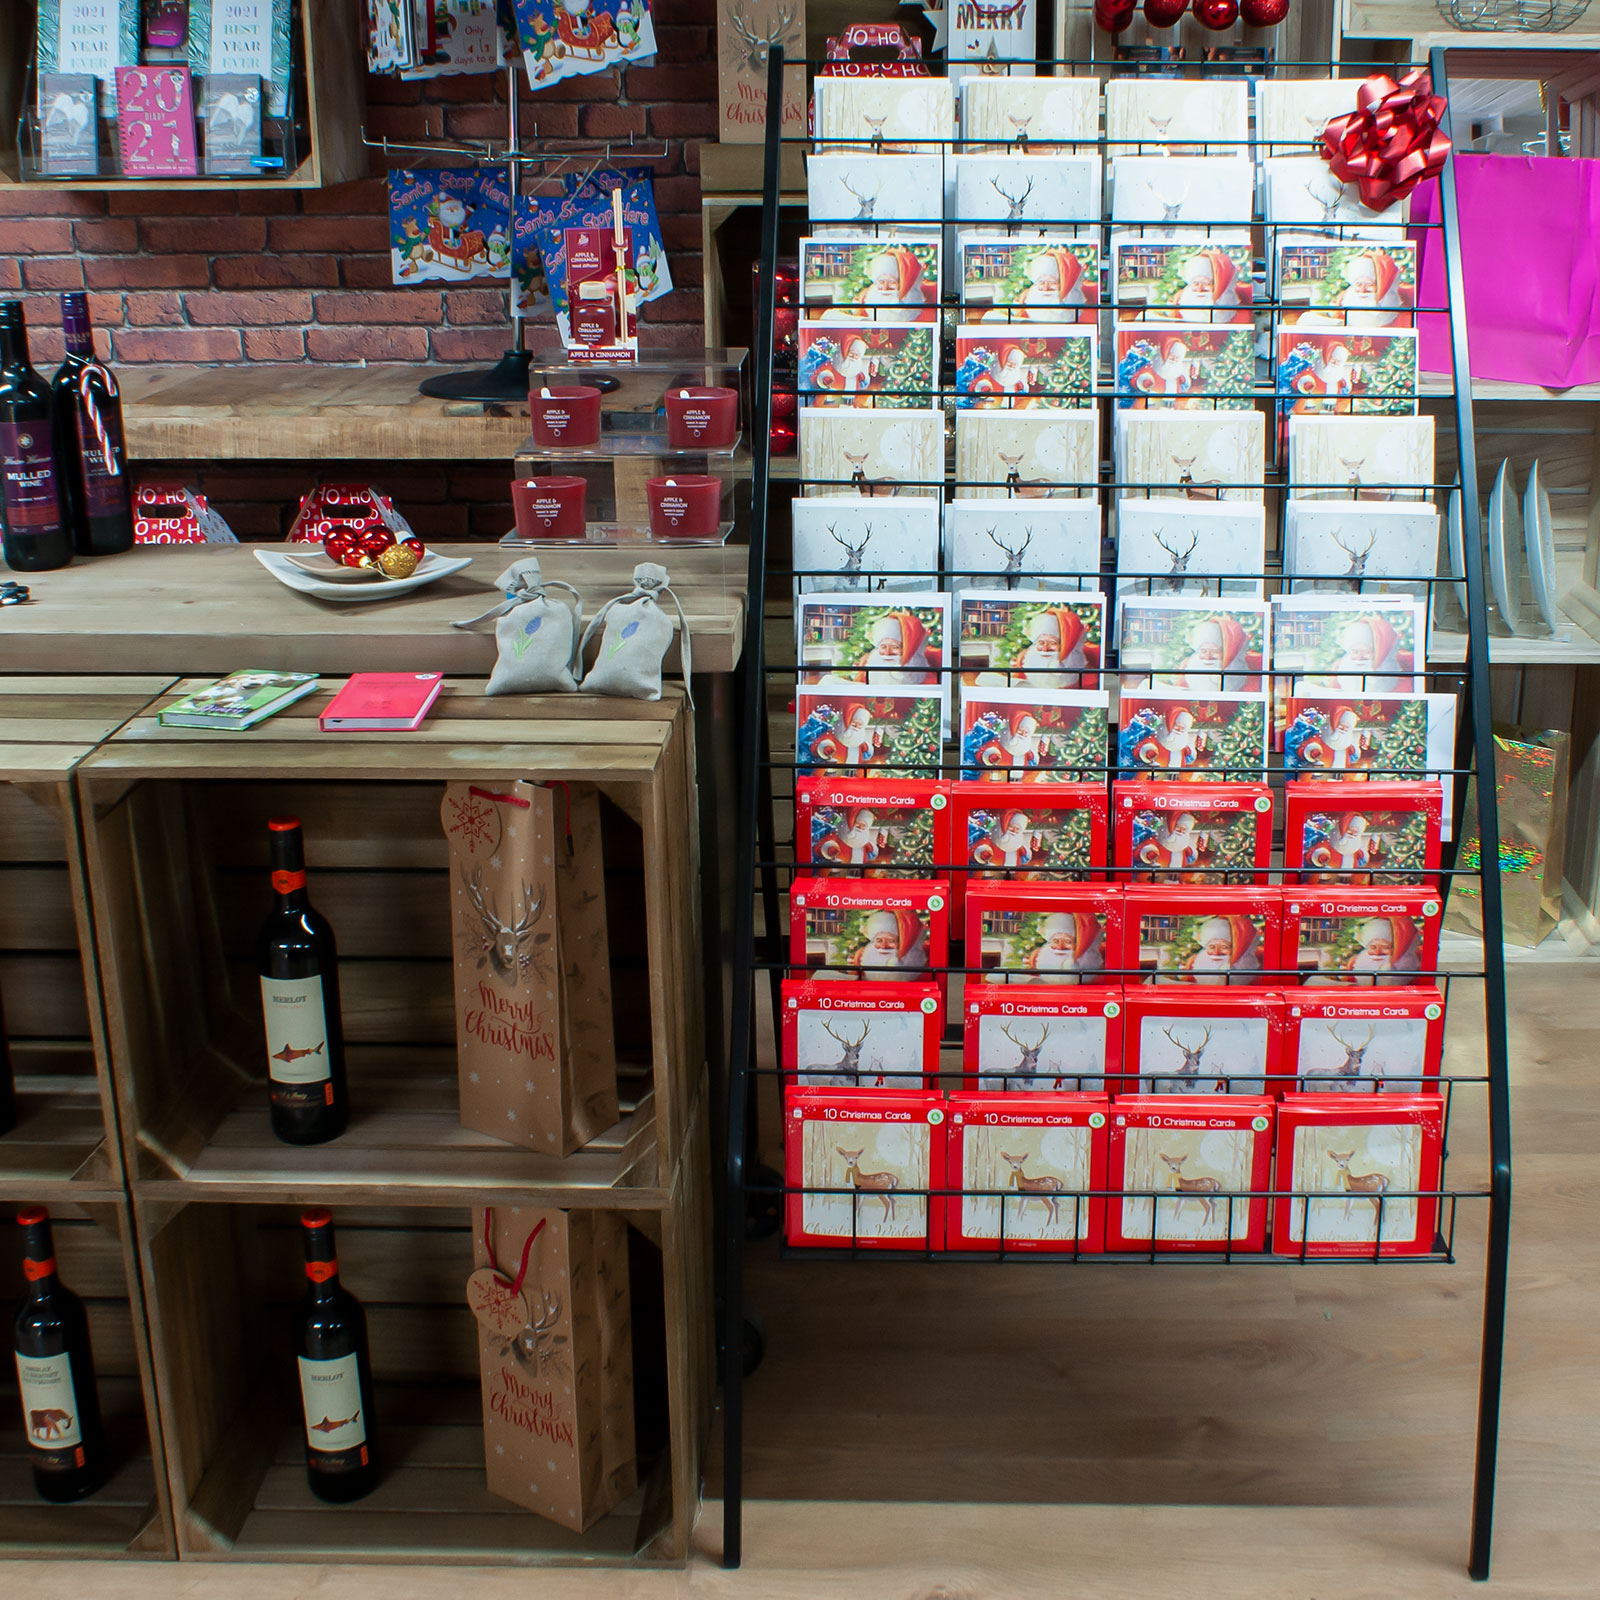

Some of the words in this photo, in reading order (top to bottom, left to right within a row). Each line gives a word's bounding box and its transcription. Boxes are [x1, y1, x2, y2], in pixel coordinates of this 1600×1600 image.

[72, 6, 105, 18] 2021
[225, 6, 258, 18] 2021
[956, 4, 1027, 30] MERRY
[71, 24, 107, 35] BEST
[224, 24, 260, 35] BEST
[465, 25, 485, 36] Only
[71, 41, 108, 52] YEAR
[223, 41, 261, 52] YEAR
[71, 57, 107, 68] EVER
[222, 57, 260, 69] EVER
[144, 112, 166, 120] DIARY
[390, 181, 433, 211] Santa
[439, 171, 475, 193] Stop
[514, 209, 555, 238] Santa
[6, 469, 52, 481] MULLED
[19, 480, 43, 488] WINE
[829, 793, 844, 804] 10
[846, 795, 887, 805] Christmas
[889, 796, 915, 805] Cards
[1153, 796, 1167, 808] 10
[1169, 799, 1211, 808] Christmas
[1213, 800, 1239, 808] Cards
[826, 895, 840, 906] 10
[842, 897, 883, 906] Christmas
[886, 898, 912, 906] Cards
[1320, 903, 1334, 913] 10
[1336, 904, 1378, 913] Christmas
[1381, 904, 1407, 913] Cards
[272, 995, 307, 1003] MERLOT
[818, 997, 832, 1008] 10
[833, 999, 876, 1009] Christmas
[878, 1000, 905, 1009] Cards
[471, 981, 536, 1031] Merry
[1000, 1002, 1014, 1014] 10
[1016, 1004, 1059, 1014] Christmas
[1061, 1005, 1088, 1014] Cards
[1322, 1006, 1336, 1017] 10
[1338, 1007, 1381, 1016] Christmas
[1383, 1007, 1409, 1016] Cards
[465, 1010, 555, 1061] Christmas
[823, 1108, 837, 1119] 10
[839, 1110, 882, 1119] Christmas
[884, 1111, 911, 1120] Cards
[984, 1113, 998, 1124] 10
[1000, 1115, 1043, 1124] Christmas
[1046, 1116, 1073, 1124] Cards
[1147, 1116, 1161, 1127] 10
[1163, 1118, 1206, 1127] Christmas
[1209, 1118, 1236, 1127] Cards
[495, 1367, 554, 1416] Merry
[490, 1391, 574, 1448] Christmas
